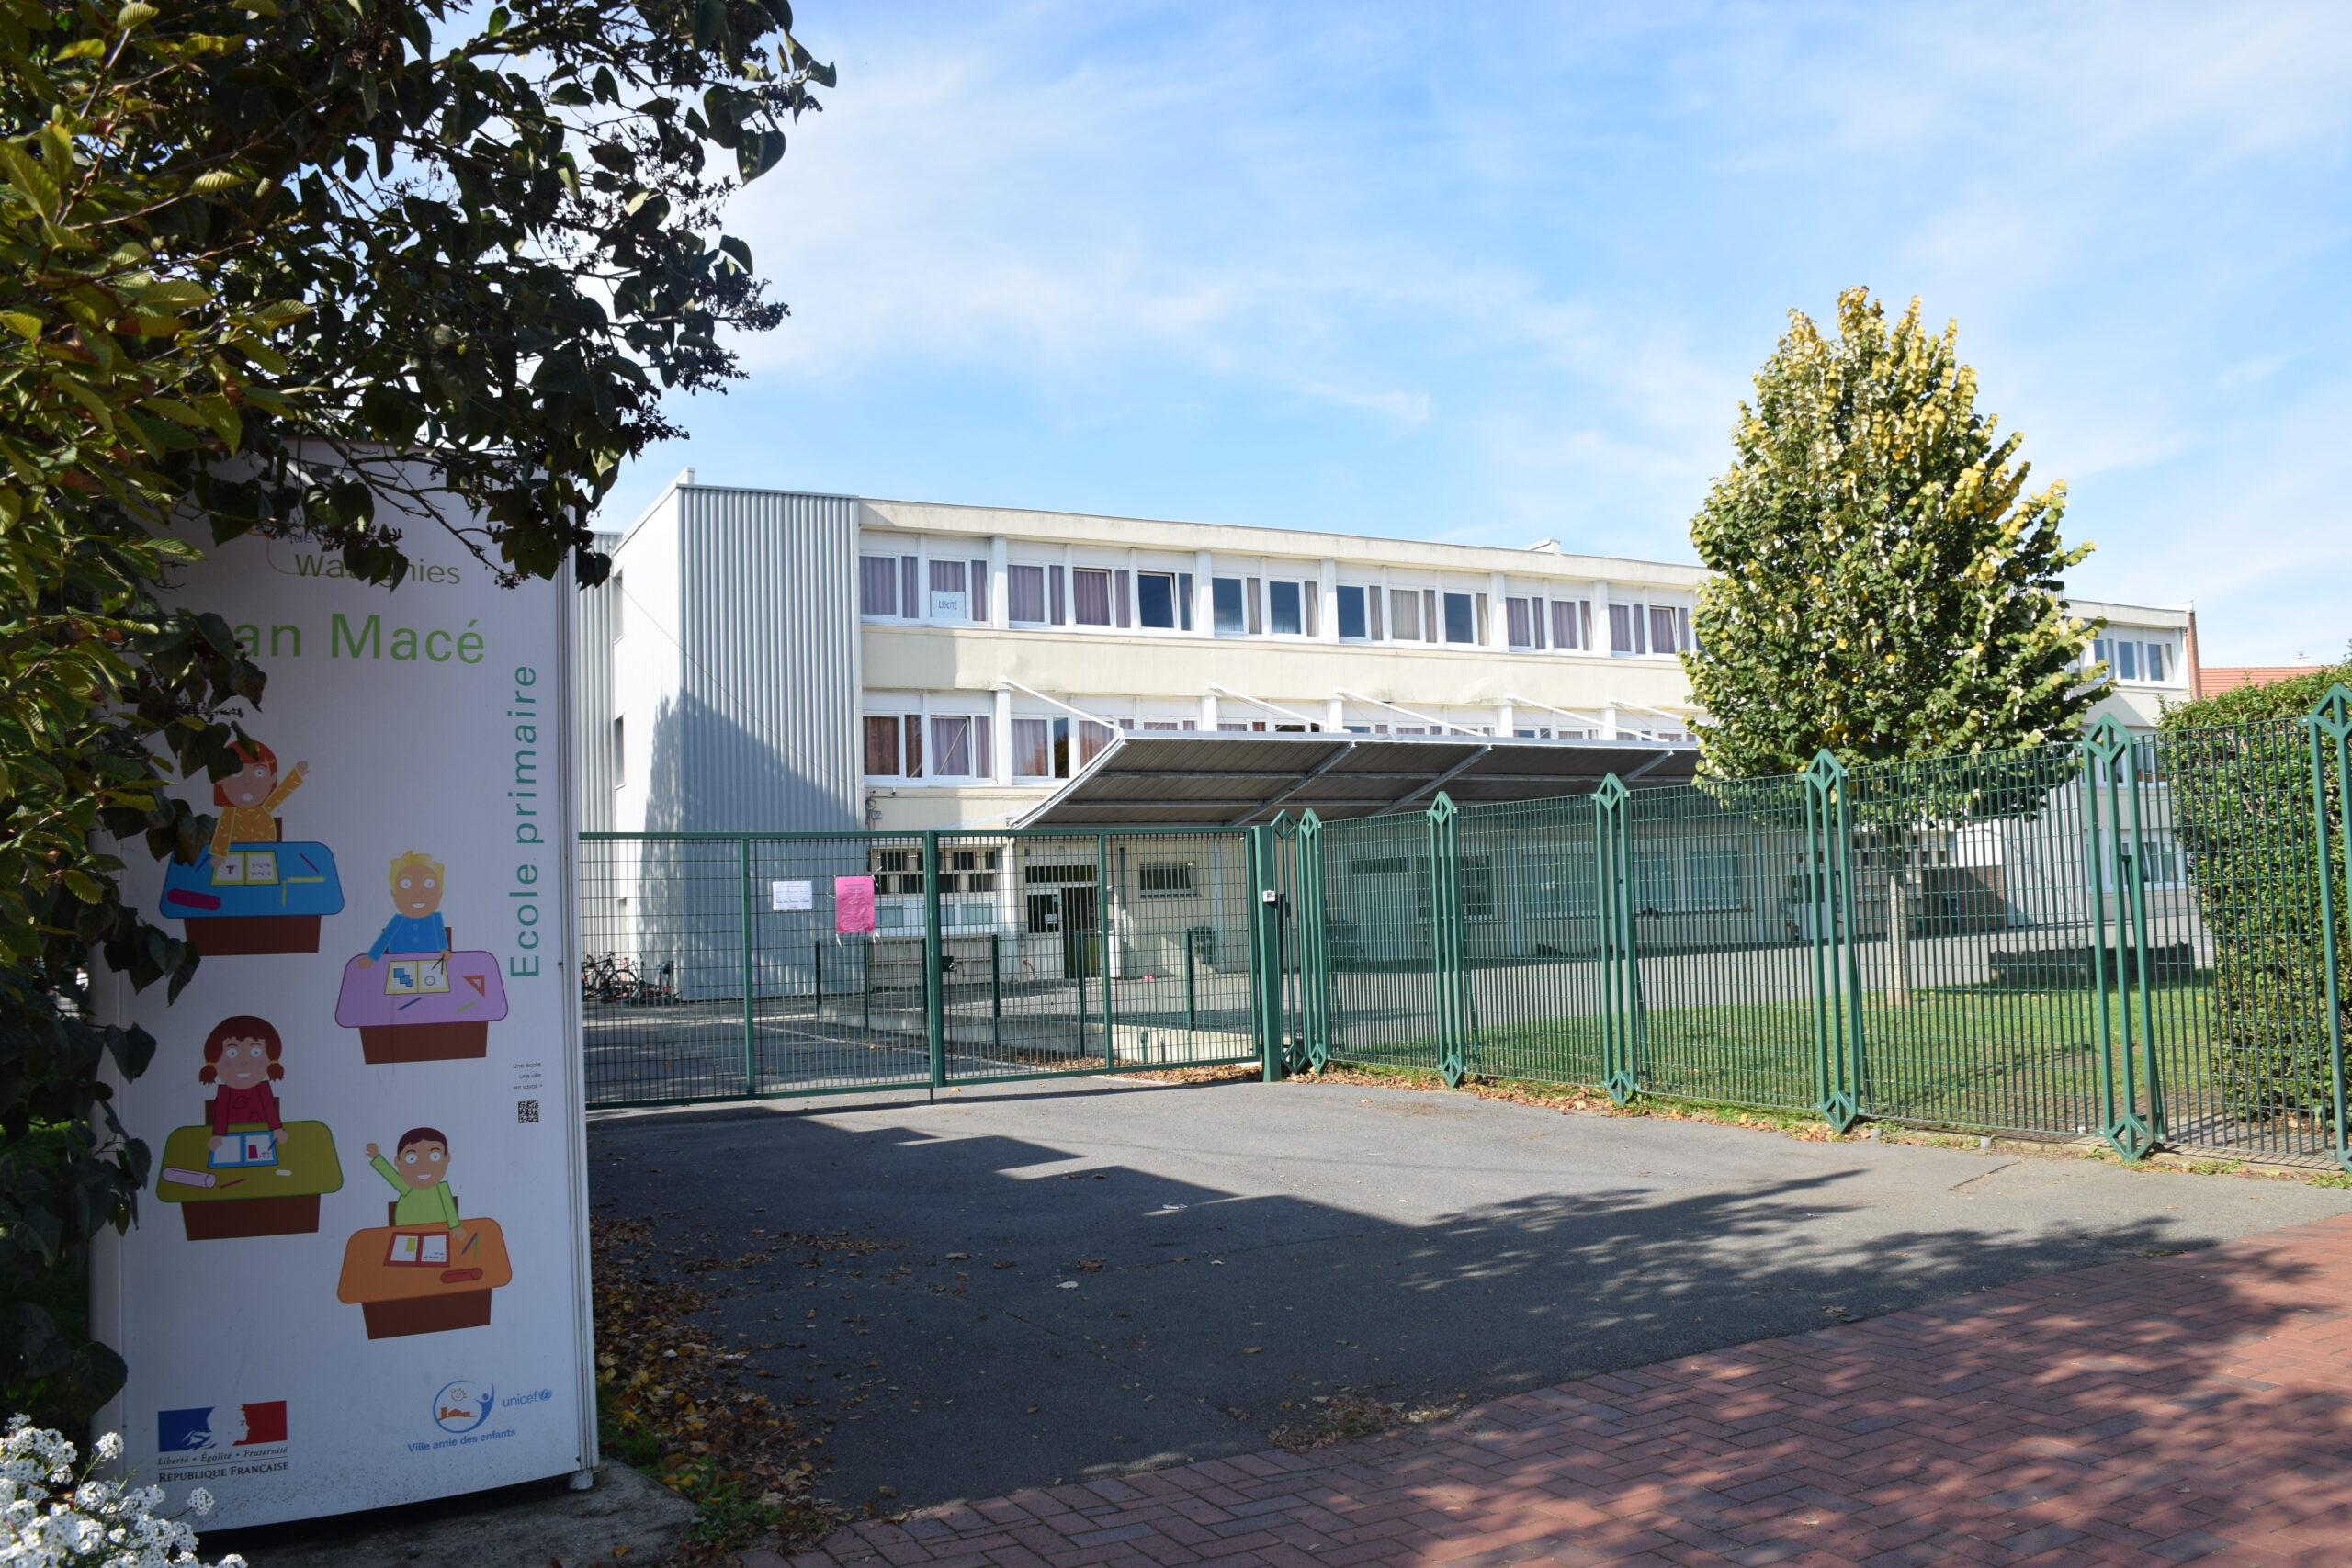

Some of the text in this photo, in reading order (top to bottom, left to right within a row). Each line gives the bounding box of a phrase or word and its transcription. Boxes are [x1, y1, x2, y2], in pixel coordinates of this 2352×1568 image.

[232, 612, 485, 664] an Macé
[506, 666, 545, 977] Ecole primaire
[502, 1390, 539, 1408] unicef
[407, 1427, 516, 1452] Ville amie des enfants
[157, 1446, 288, 1465] Liberté Égalité Fraternité
[158, 1461, 289, 1483] RÉPUBLIQUE FRANÇAISE
